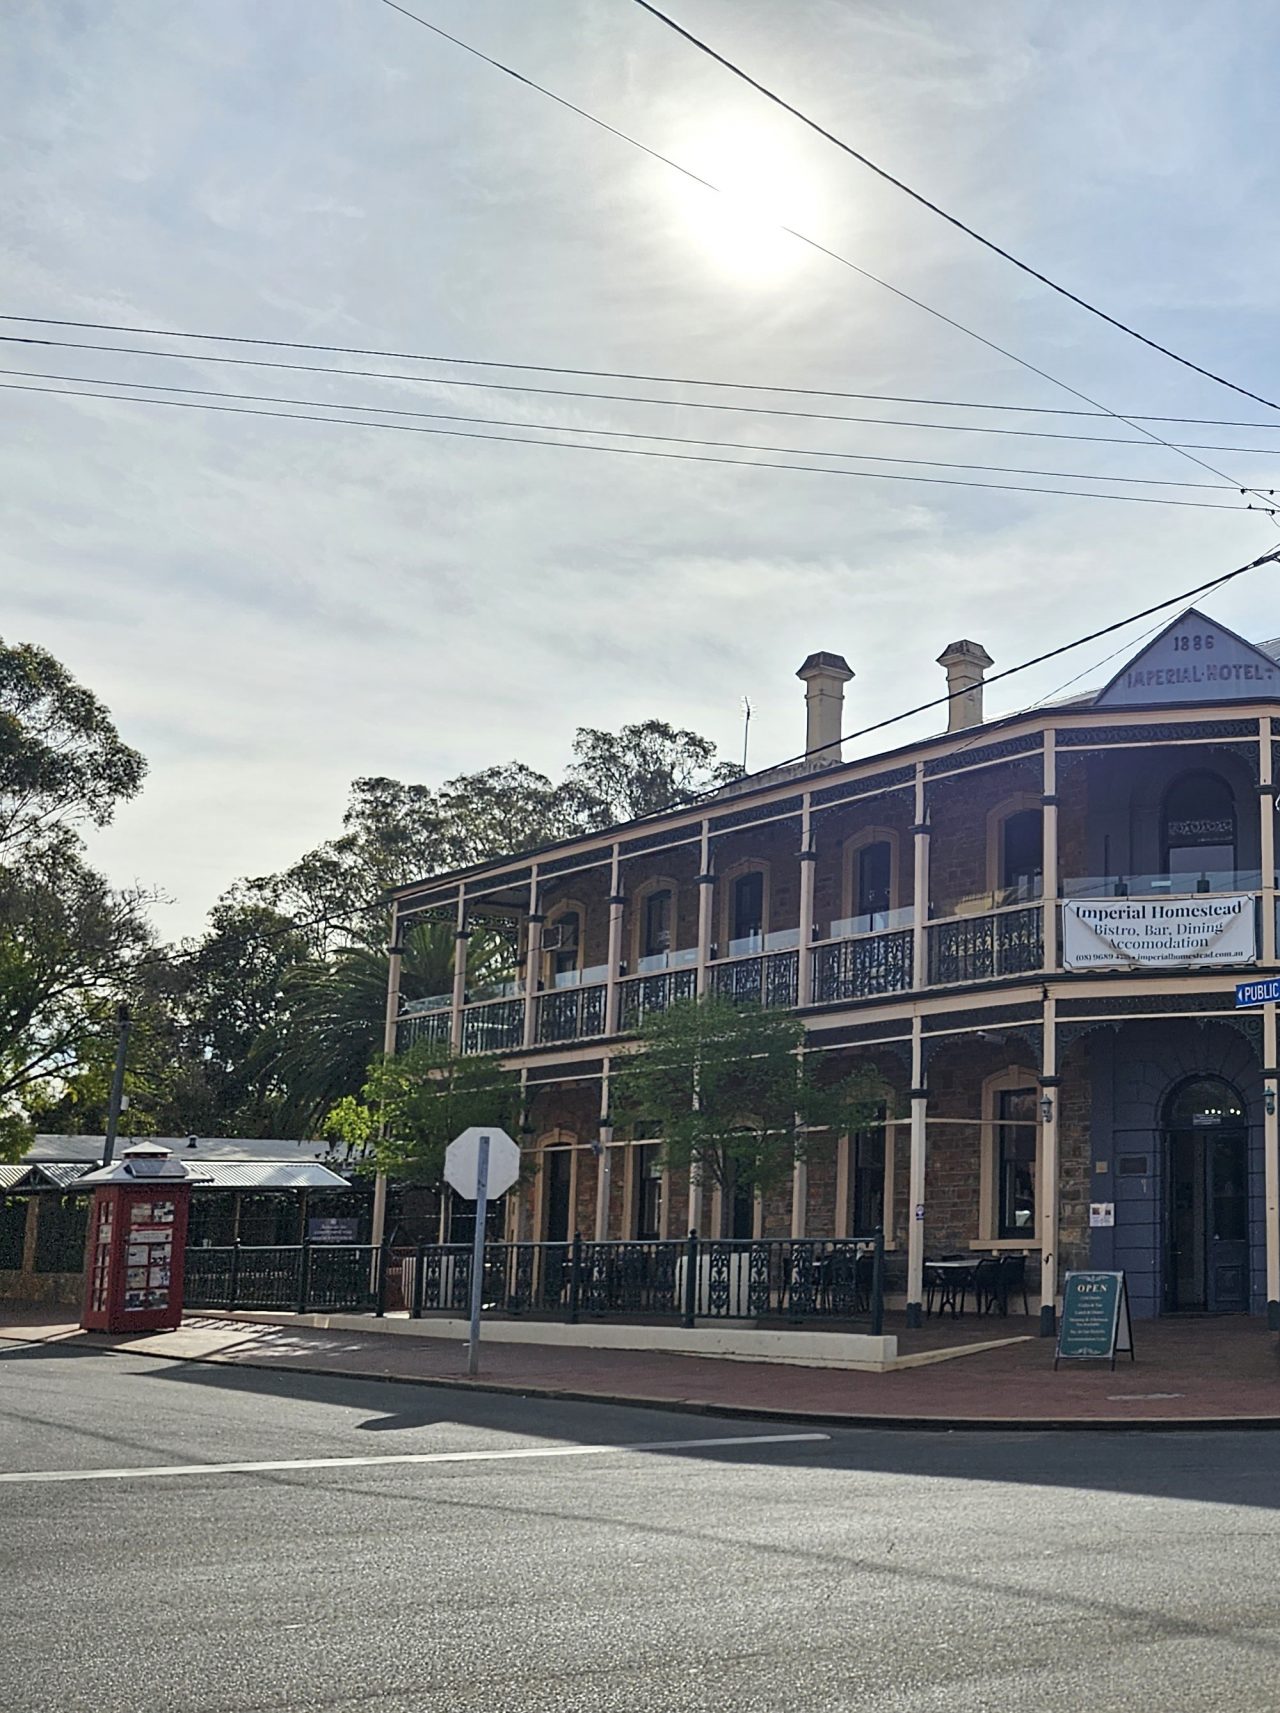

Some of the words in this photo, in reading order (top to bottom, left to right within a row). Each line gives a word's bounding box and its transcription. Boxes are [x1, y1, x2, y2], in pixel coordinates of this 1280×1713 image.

[1174, 635, 1214, 652] 1886
[1076, 905, 1146, 921] Imperial
[1152, 901, 1241, 918] Homestead
[1177, 922, 1223, 935] Dining
[1109, 937, 1209, 950] Accomodation
[1244, 982, 1279, 1001] PUBLIC
[1077, 1284, 1108, 1293] OPEN
